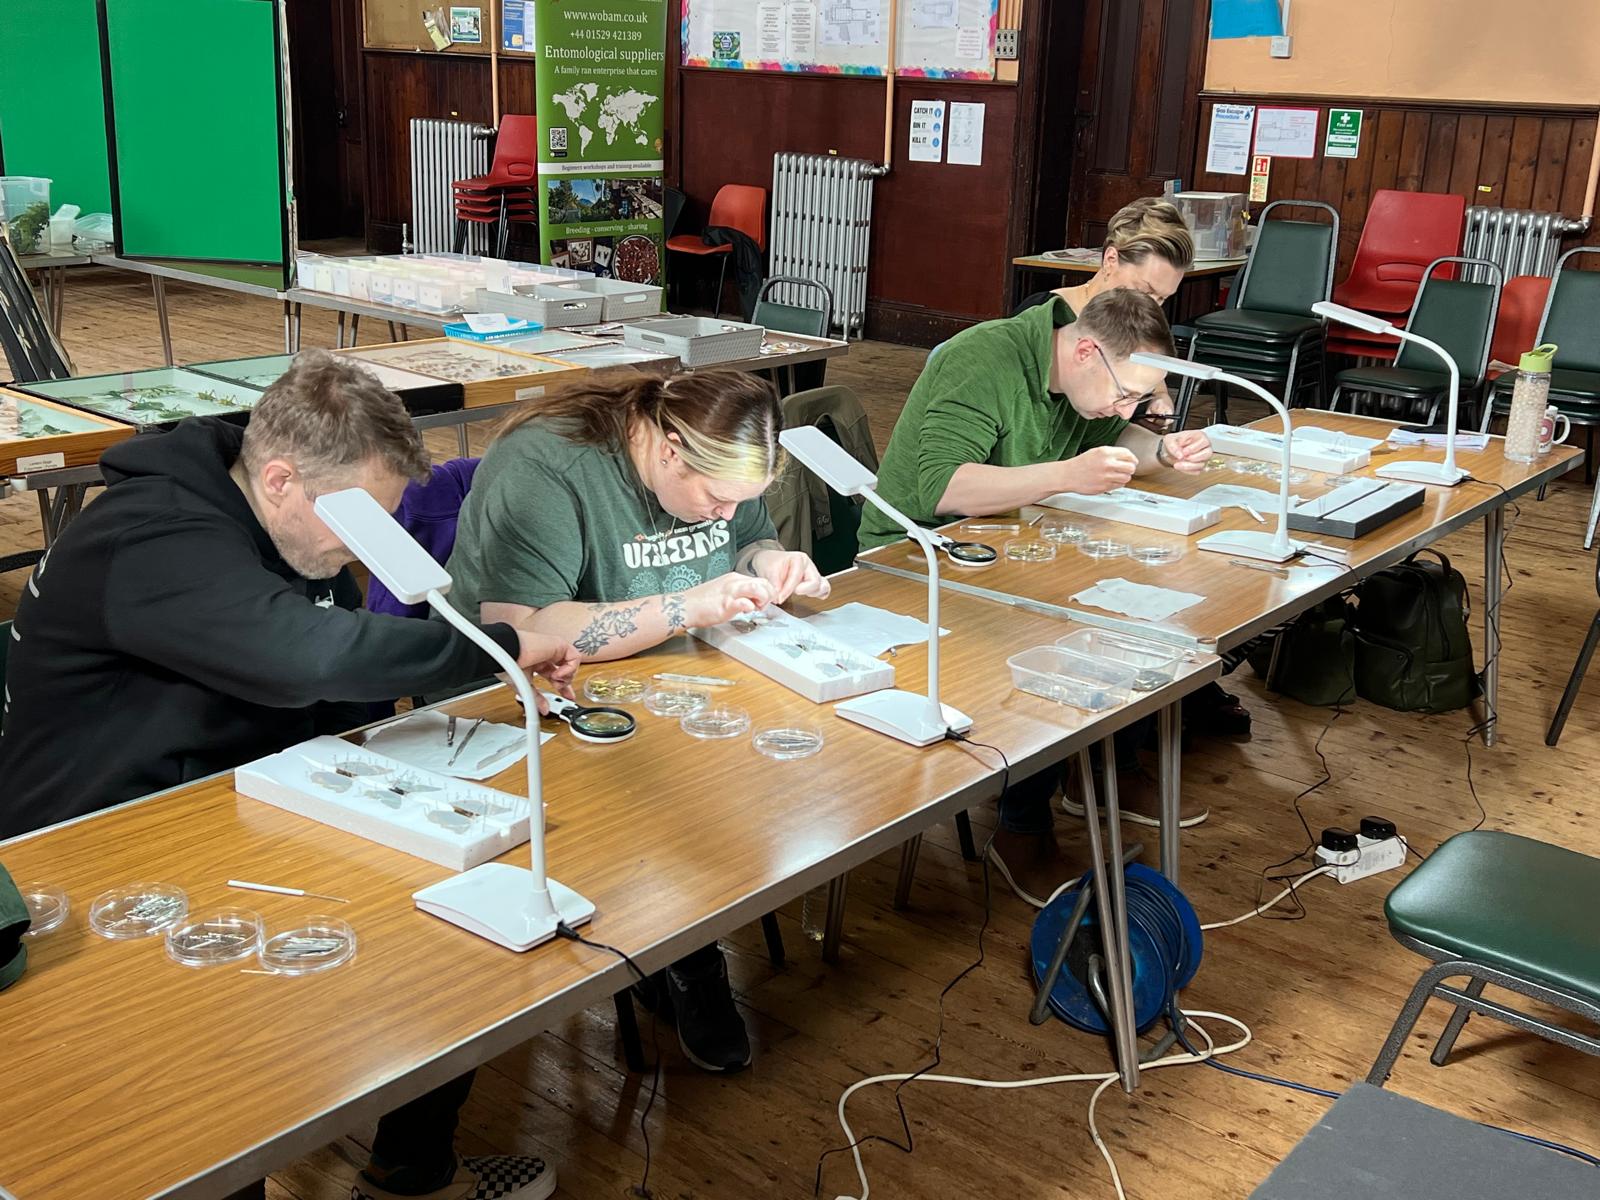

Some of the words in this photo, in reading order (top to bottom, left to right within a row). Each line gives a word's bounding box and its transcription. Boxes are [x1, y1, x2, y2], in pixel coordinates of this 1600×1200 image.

[564, 10, 648, 23] www.wobam.co.uk
[570, 29, 584, 39] +44
[586, 30, 610, 40] 01529
[612, 31, 642, 41] 421389
[545, 45, 617, 62] Entomological
[620, 47, 664, 63] suppliers
[554, 65, 560, 74] A
[561, 66, 579, 76] family
[593, 67, 625, 76] enterprise
[626, 66, 639, 75] that
[640, 68, 657, 76] cares
[566, 226, 591, 234] Breeding
